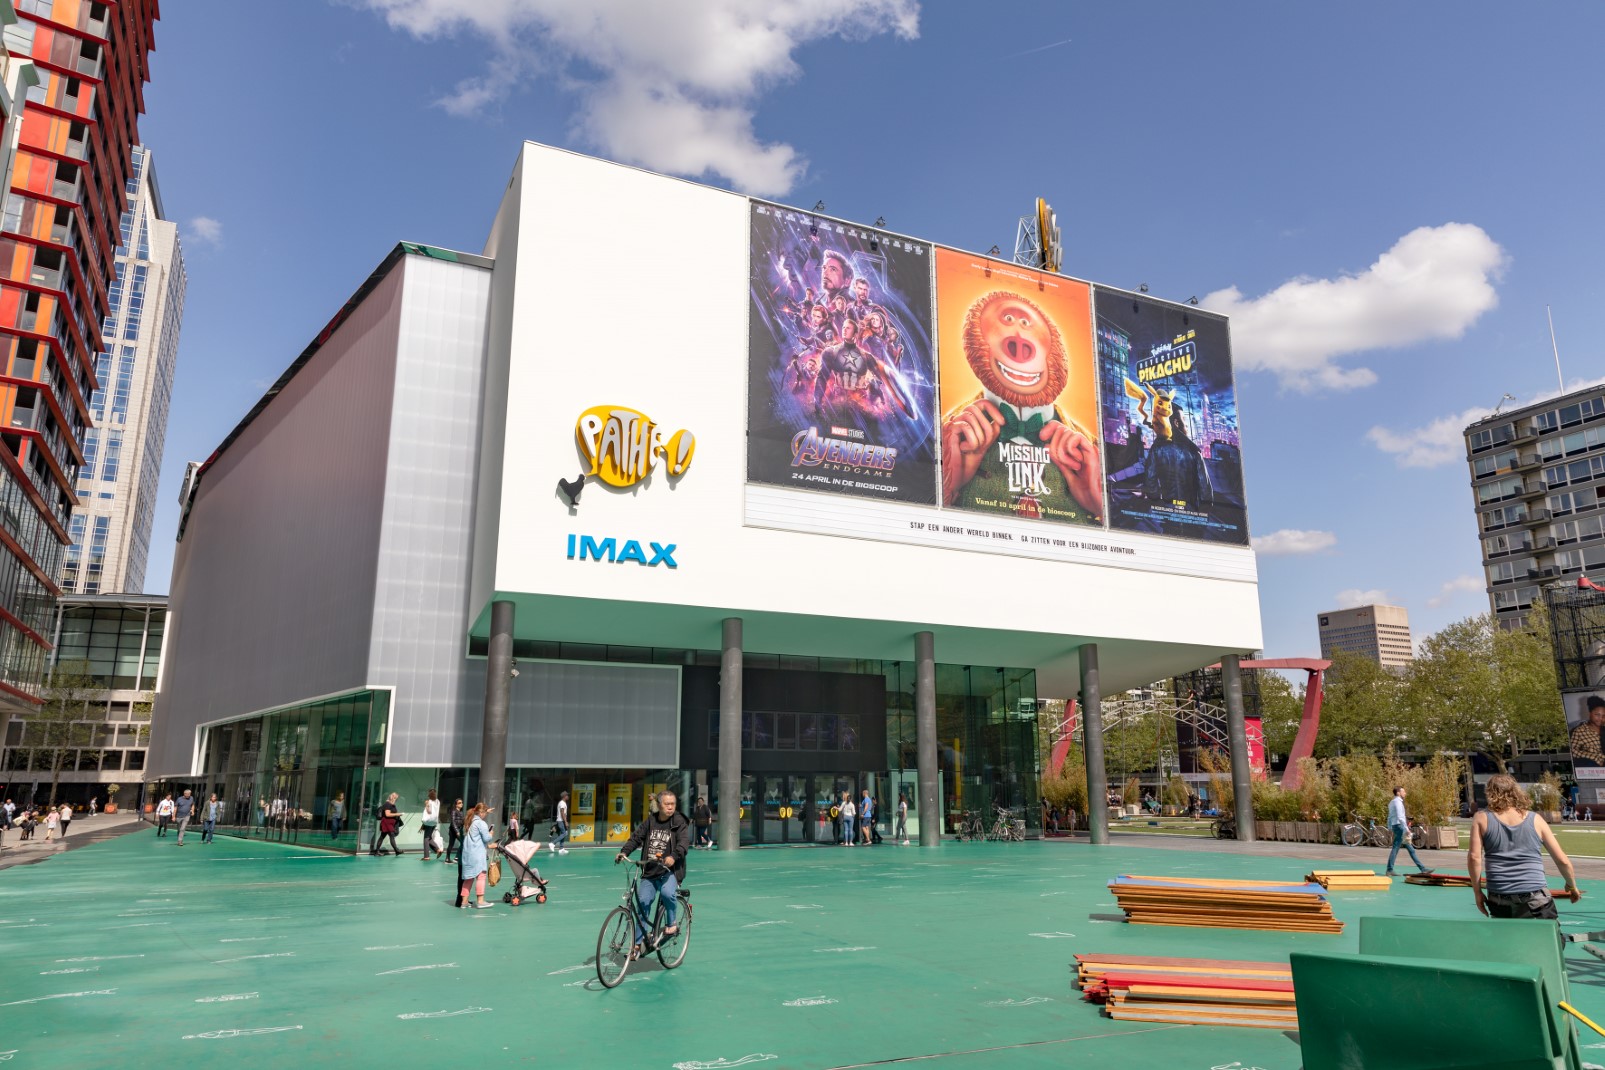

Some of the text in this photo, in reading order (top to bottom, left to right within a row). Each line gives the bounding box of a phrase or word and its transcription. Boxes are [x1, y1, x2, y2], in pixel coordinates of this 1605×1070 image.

[1138, 353, 1192, 383] PIKACHU
[831, 426, 865, 439] MARVEL STUDIOS
[791, 426, 898, 471] AVENGERS
[998, 441, 1051, 464] MISSING
[791, 472, 898, 493] 24 APRIL IN DE BIOSCOOP
[823, 463, 893, 478] ENDGAME
[1005, 462, 1052, 497] LINK
[975, 497, 998, 507] Vanaf
[1008, 502, 1027, 511] april
[1037, 505, 1046, 514] de
[1047, 506, 1076, 519] bioscoop
[566, 533, 678, 569] IMAX
[910, 521, 925, 530] STAP
[928, 523, 939, 531] EEN
[942, 525, 964, 535] ANDERE
[966, 528, 990, 538] WERELD
[992, 531, 1014, 541] BINNEN.
[1020, 535, 1029, 543] GA
[1031, 536, 1050, 545] ZITTEN
[1081, 541, 1108, 552] BIJZONDER
[1110, 545, 1137, 555] AVONTUUR.
